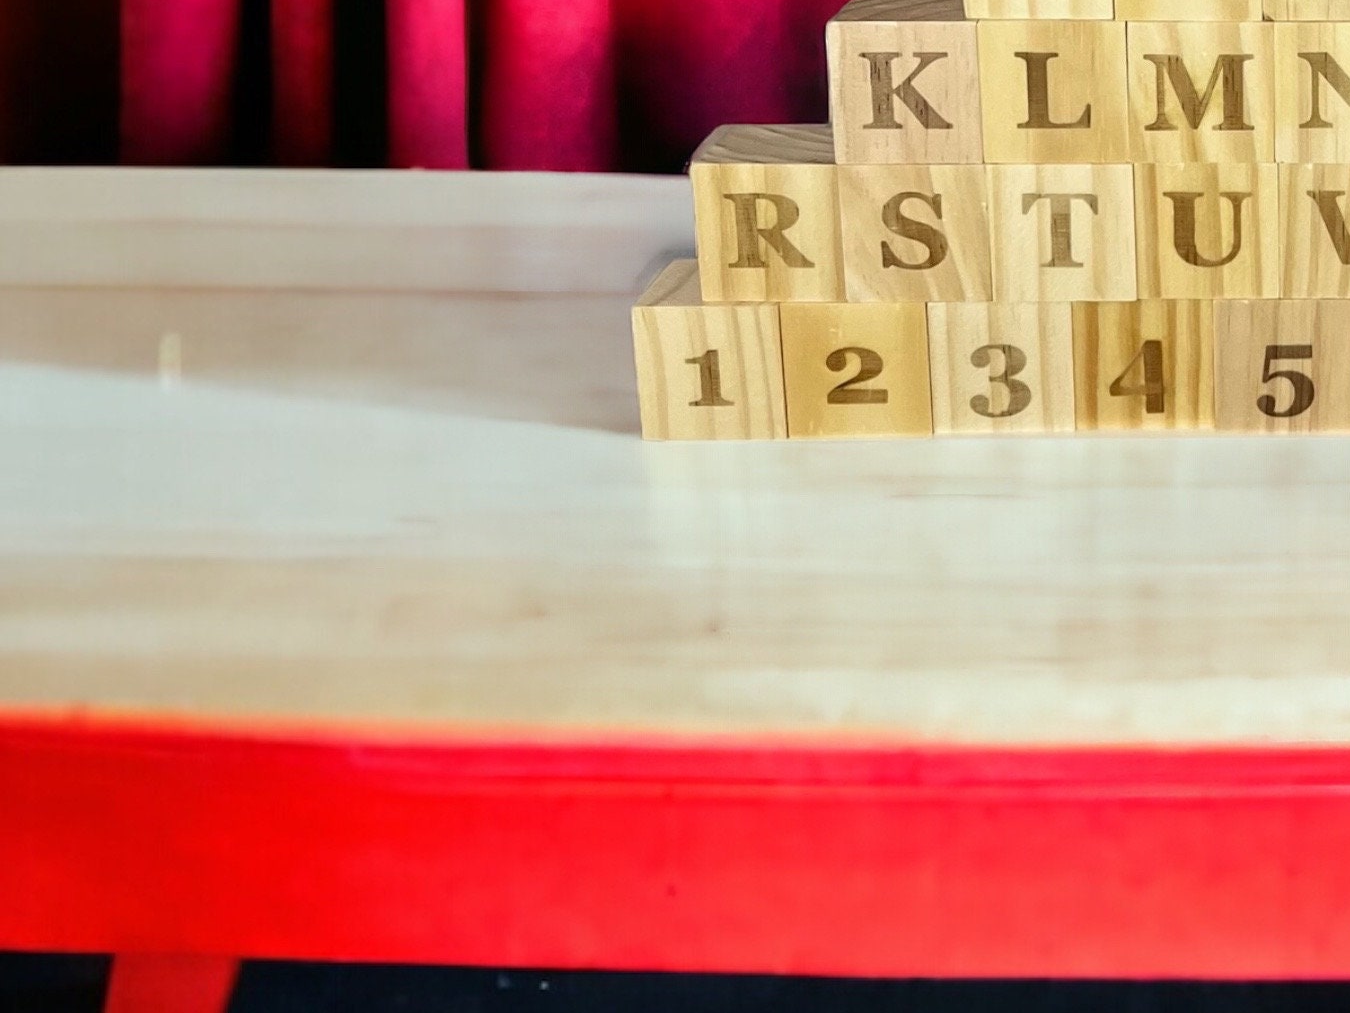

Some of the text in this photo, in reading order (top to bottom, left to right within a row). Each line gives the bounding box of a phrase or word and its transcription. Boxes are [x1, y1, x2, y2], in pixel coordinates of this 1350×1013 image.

[858, 51, 954, 129] K
[1014, 52, 1092, 129] L
[1142, 54, 1256, 132] M
[722, 192, 816, 269] R
[880, 191, 948, 270] S
[1022, 193, 1099, 268] T
[1162, 192, 1254, 268] U
[685, 349, 735, 407] 1
[825, 346, 889, 405] 2
[969, 344, 1031, 418] 3
[1109, 339, 1166, 414] 4
[1256, 344, 1315, 417] 5
